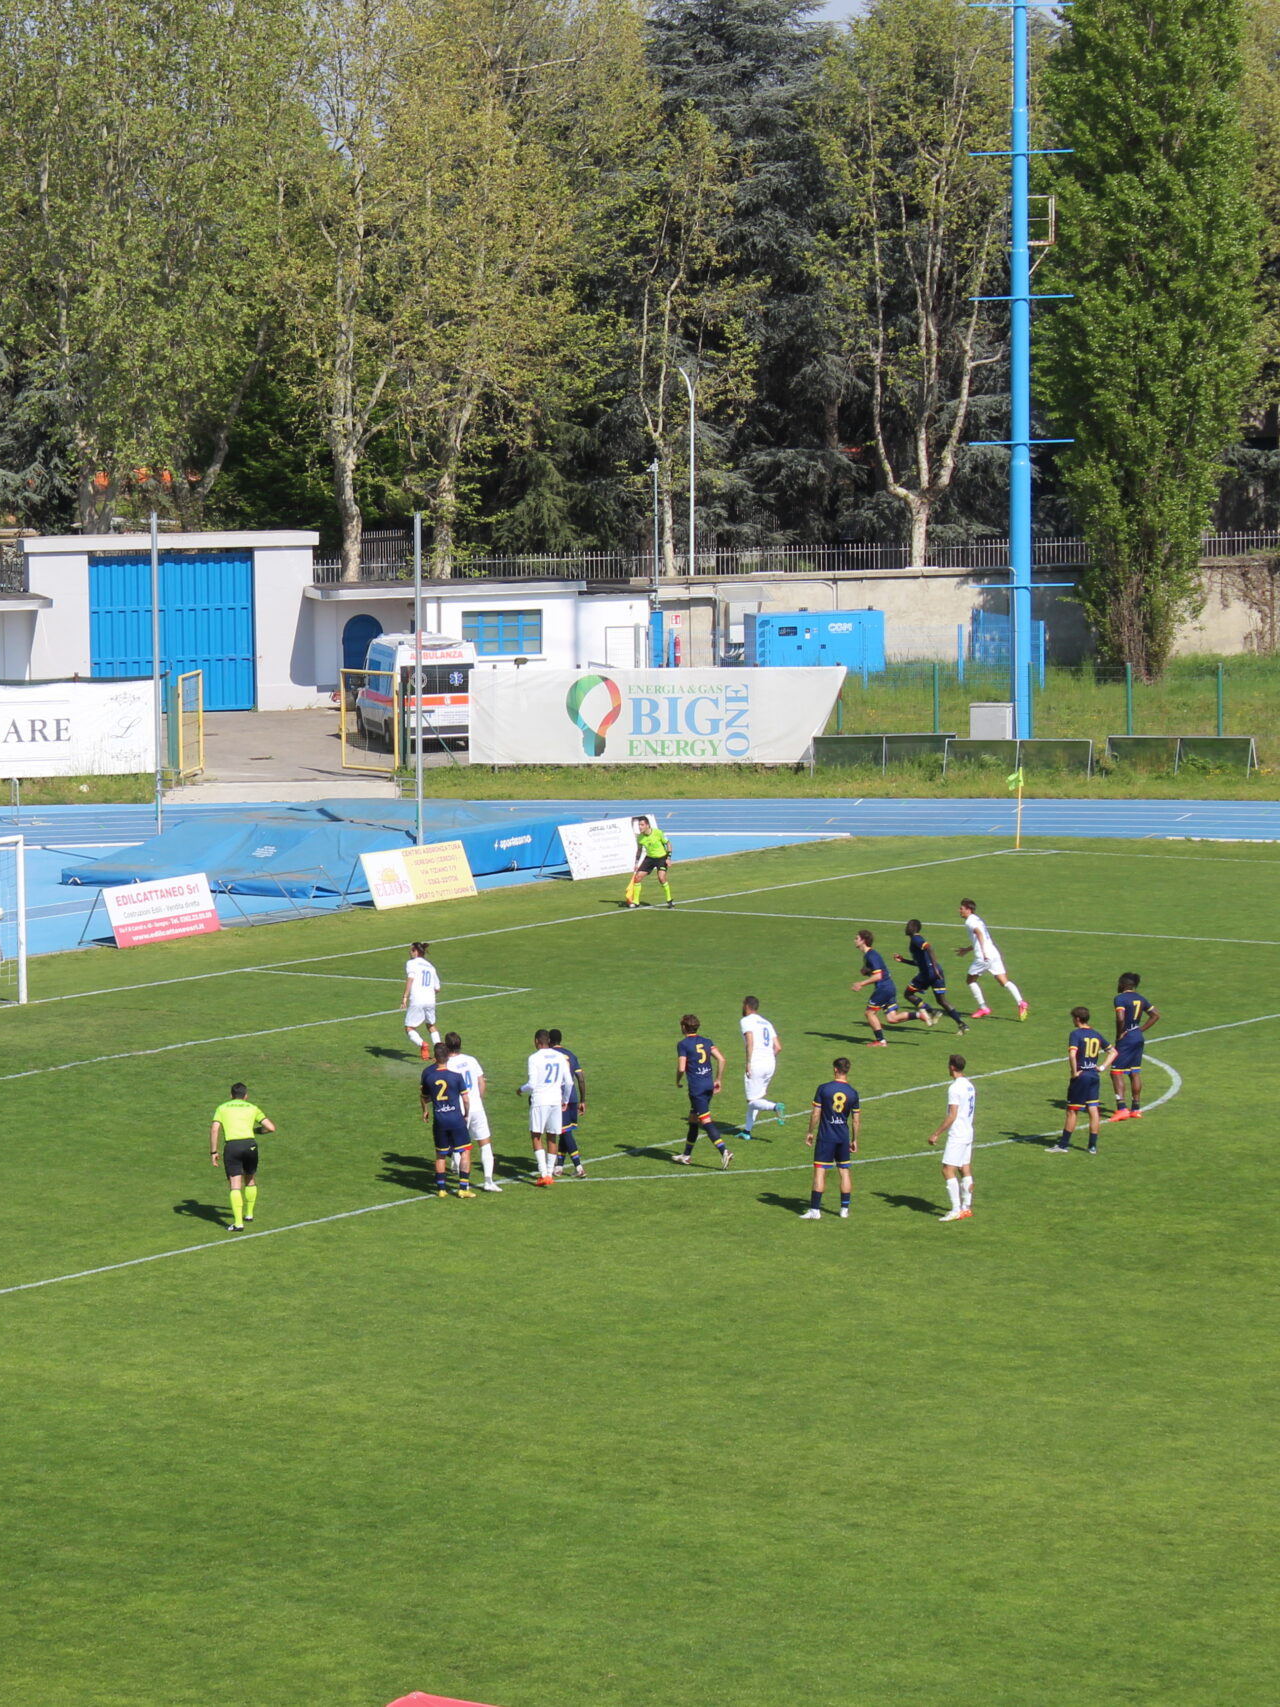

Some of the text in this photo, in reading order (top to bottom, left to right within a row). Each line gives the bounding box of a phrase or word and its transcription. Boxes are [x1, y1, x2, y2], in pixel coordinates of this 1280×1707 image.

[410, 650, 464, 660] ABULANZA
[627, 696, 724, 736] BIG
[724, 684, 751, 757] ONE
[628, 739, 722, 757] ENERGY
[115, 883, 200, 907] EDILCATTANEO Srl
[123, 908, 151, 919] Costruzioni
[151, 906, 163, 914] Edili
[166, 903, 184, 913] Vendita
[421, 970, 431, 987] 10
[1132, 1000, 1142, 1020] 7
[763, 1027, 770, 1047] 9
[1083, 1037, 1100, 1058] 10
[695, 1043, 707, 1064] 5
[544, 1063, 559, 1084] 27
[435, 1080, 449, 1101] 2
[832, 1091, 847, 1113] 8
